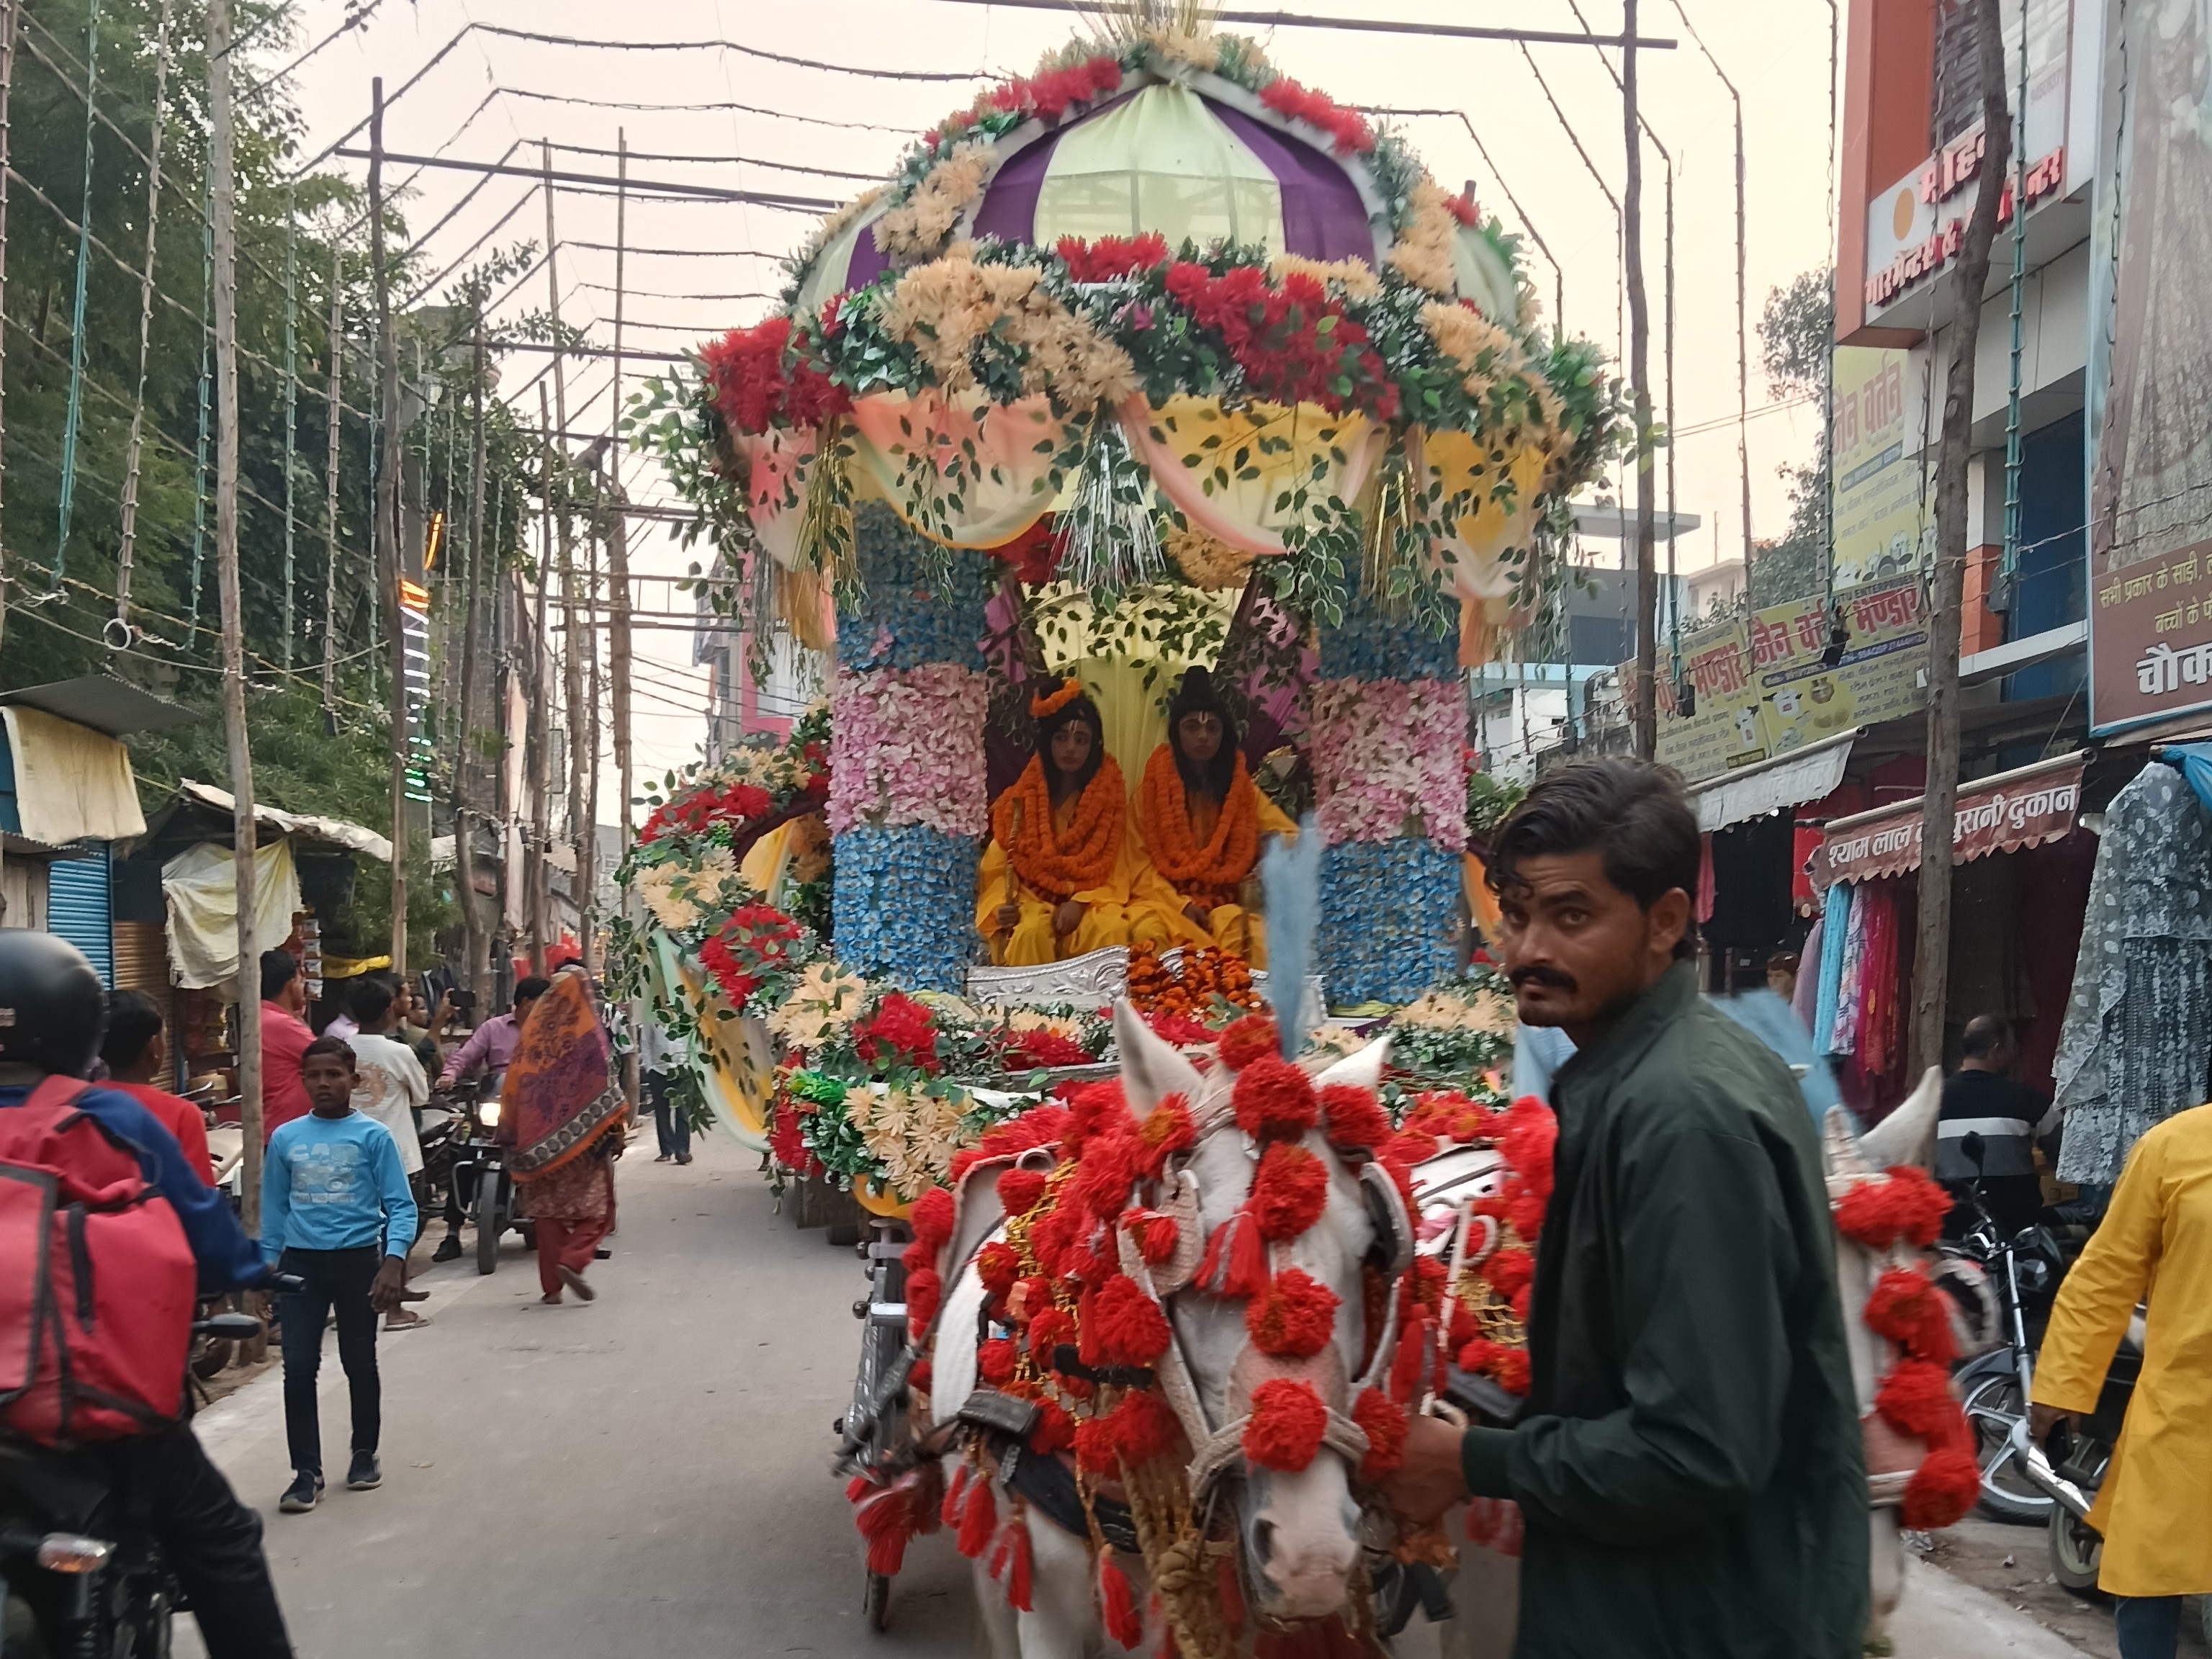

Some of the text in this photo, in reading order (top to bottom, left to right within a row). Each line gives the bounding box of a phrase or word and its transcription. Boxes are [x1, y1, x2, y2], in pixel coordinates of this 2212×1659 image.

[2099, 577, 2121, 608] सभी
[2124, 573, 2153, 603] प्रकार
[2156, 562, 2169, 589] के
[2186, 595, 2200, 624] के
[1828, 835, 1870, 868] श्याम
[1872, 824, 1913, 857] लाल
[2008, 783, 2079, 830] दुकान
